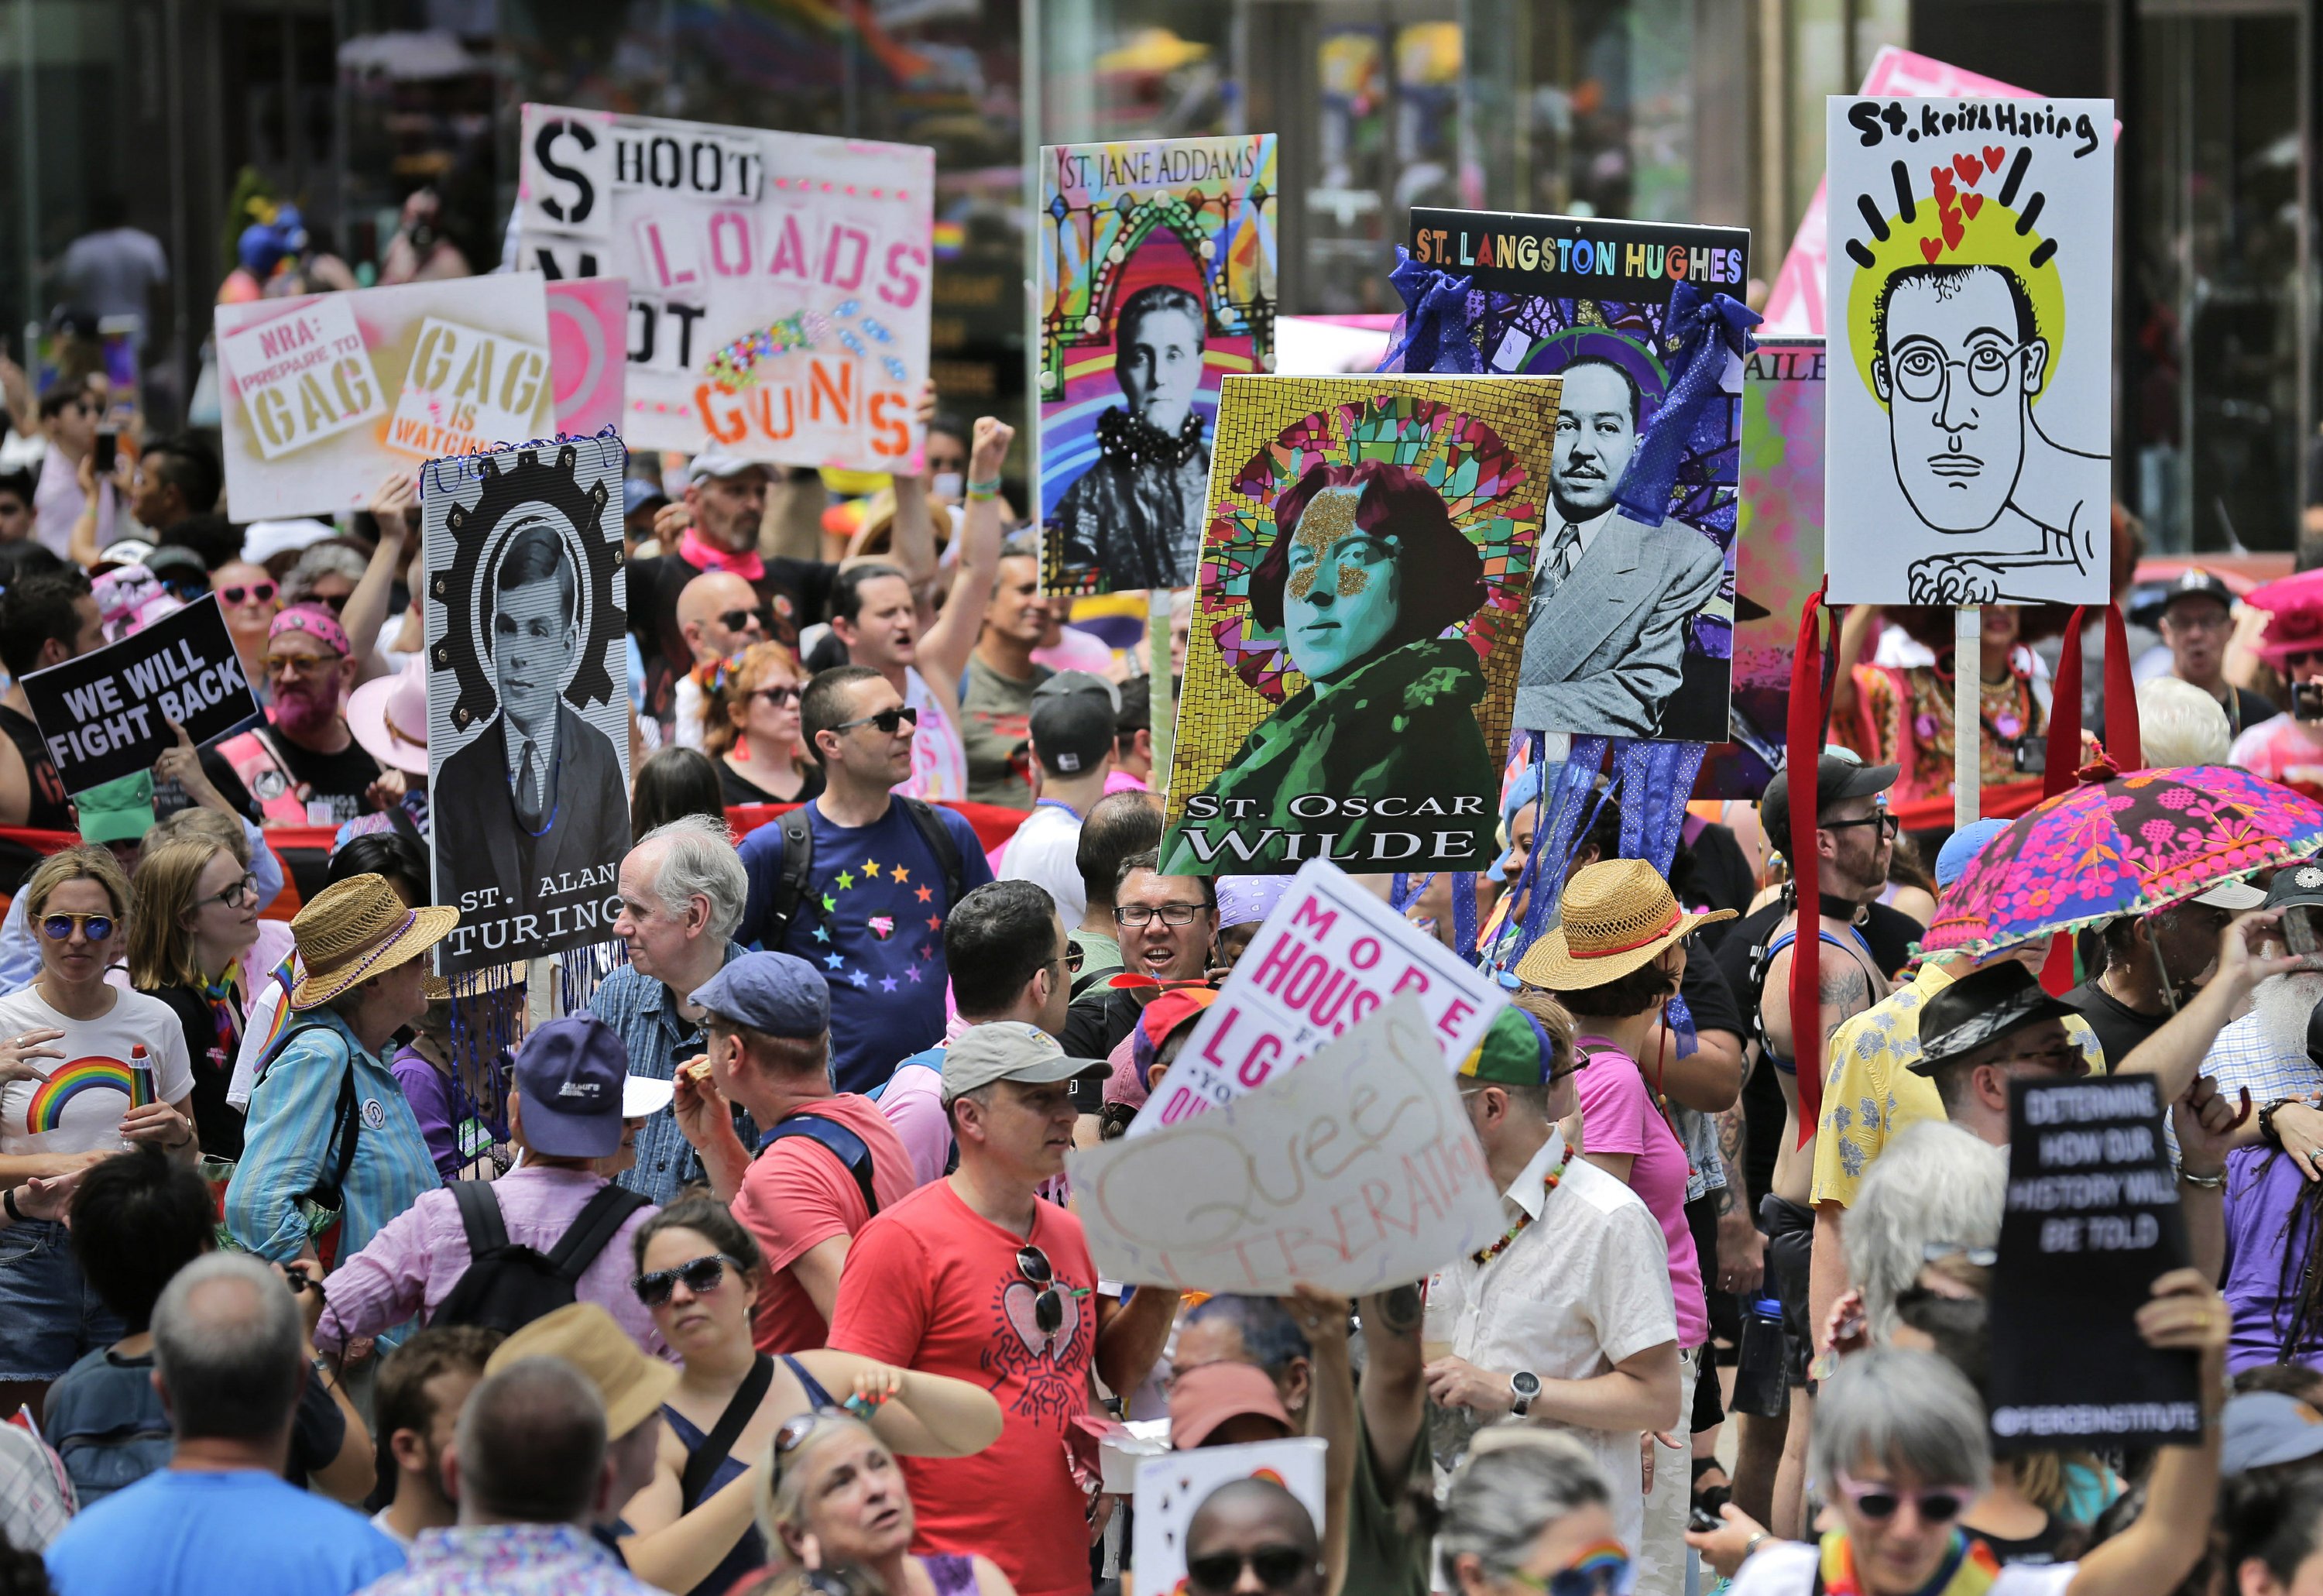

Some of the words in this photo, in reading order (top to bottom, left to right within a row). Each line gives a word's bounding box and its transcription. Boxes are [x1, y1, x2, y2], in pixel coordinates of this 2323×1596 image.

[534, 118, 762, 224] SHOOT
[1065, 156, 1091, 189] ST.
[1097, 152, 1151, 195] JANE
[1157, 146, 1254, 184] ADDAMS
[647, 211, 927, 308] LOADS
[1416, 228, 1452, 265] ST.
[1460, 232, 1616, 276] LANGSTON
[1625, 243, 1742, 284] HUGHES
[241, 347, 330, 392] PREPARE
[336, 333, 360, 357] TO
[413, 325, 542, 415] GAG
[254, 356, 372, 446] GAG
[448, 396, 477, 432] IS
[695, 359, 911, 457] GUNS
[62, 675, 124, 722] WE
[122, 638, 205, 700] WILL
[46, 703, 152, 769] FIGHT
[157, 655, 246, 724] BACK
[460, 887, 514, 913] ST.
[537, 862, 616, 898] ALAN
[448, 894, 624, 956] TURING
[2025, 1083, 2158, 1125] DETERMINE
[2039, 1131, 2102, 1168] HOW
[2103, 1126, 2155, 1163] OUR
[2008, 1173, 2120, 1211] HISTORY
[2122, 1170, 2180, 1205] WILL
[2040, 1217, 2084, 1253] BE
[2088, 1212, 2159, 1251] TOLD
